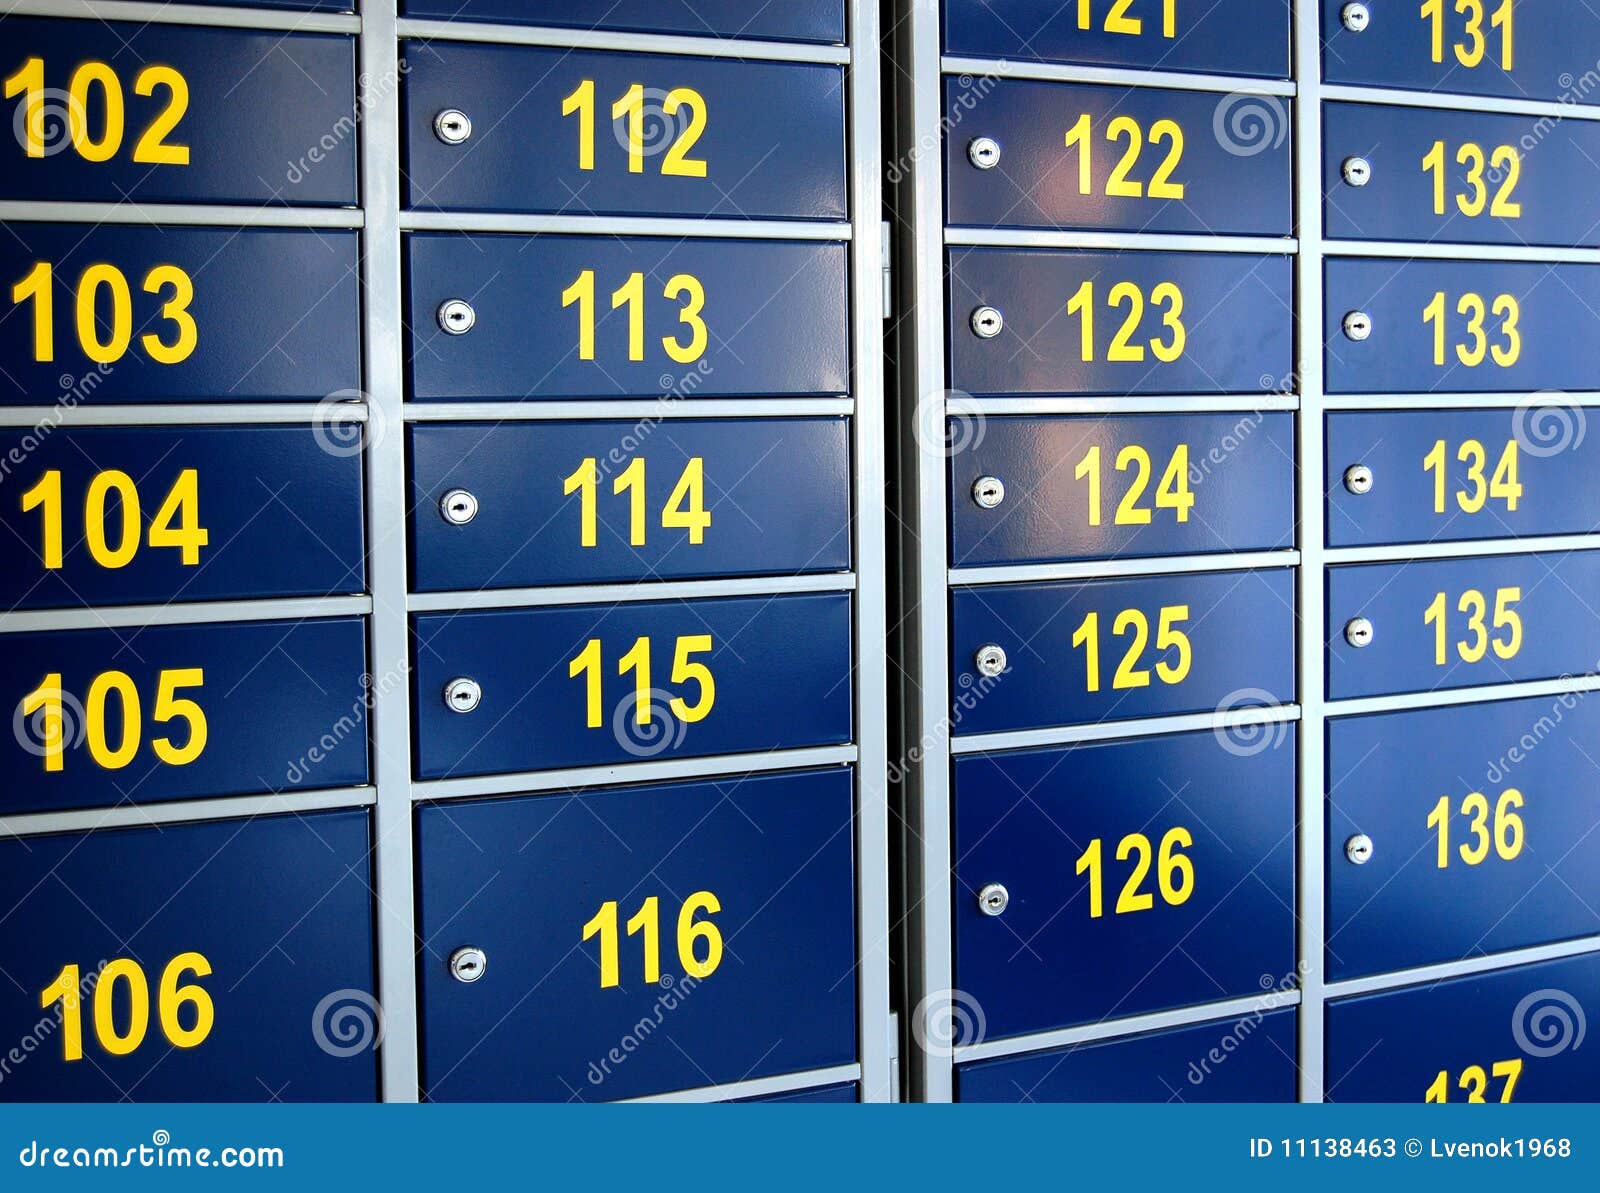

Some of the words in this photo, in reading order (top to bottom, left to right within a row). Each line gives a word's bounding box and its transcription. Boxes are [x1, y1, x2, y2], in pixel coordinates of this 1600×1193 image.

[1421, 0, 1513, 70] 131
[5, 58, 190, 165] 102
[561, 80, 708, 177] 112
[1064, 114, 1185, 200] 122
[1422, 140, 1521, 218] 132
[13, 262, 198, 364] 103
[561, 270, 708, 364] 113
[1066, 281, 1186, 363] 123
[1423, 292, 1521, 367] 133
[22, 469, 209, 570] 104
[563, 458, 712, 547] 114
[1074, 445, 1195, 527] 124
[1424, 440, 1523, 513] 134
[1072, 605, 1192, 692] 125
[1425, 588, 1523, 665] 135
[22, 668, 208, 772] 105
[569, 635, 716, 728] 115
[1075, 827, 1195, 918] 126
[1427, 789, 1524, 868] 136
[582, 891, 724, 988] 116
[41, 952, 215, 1061] 106
